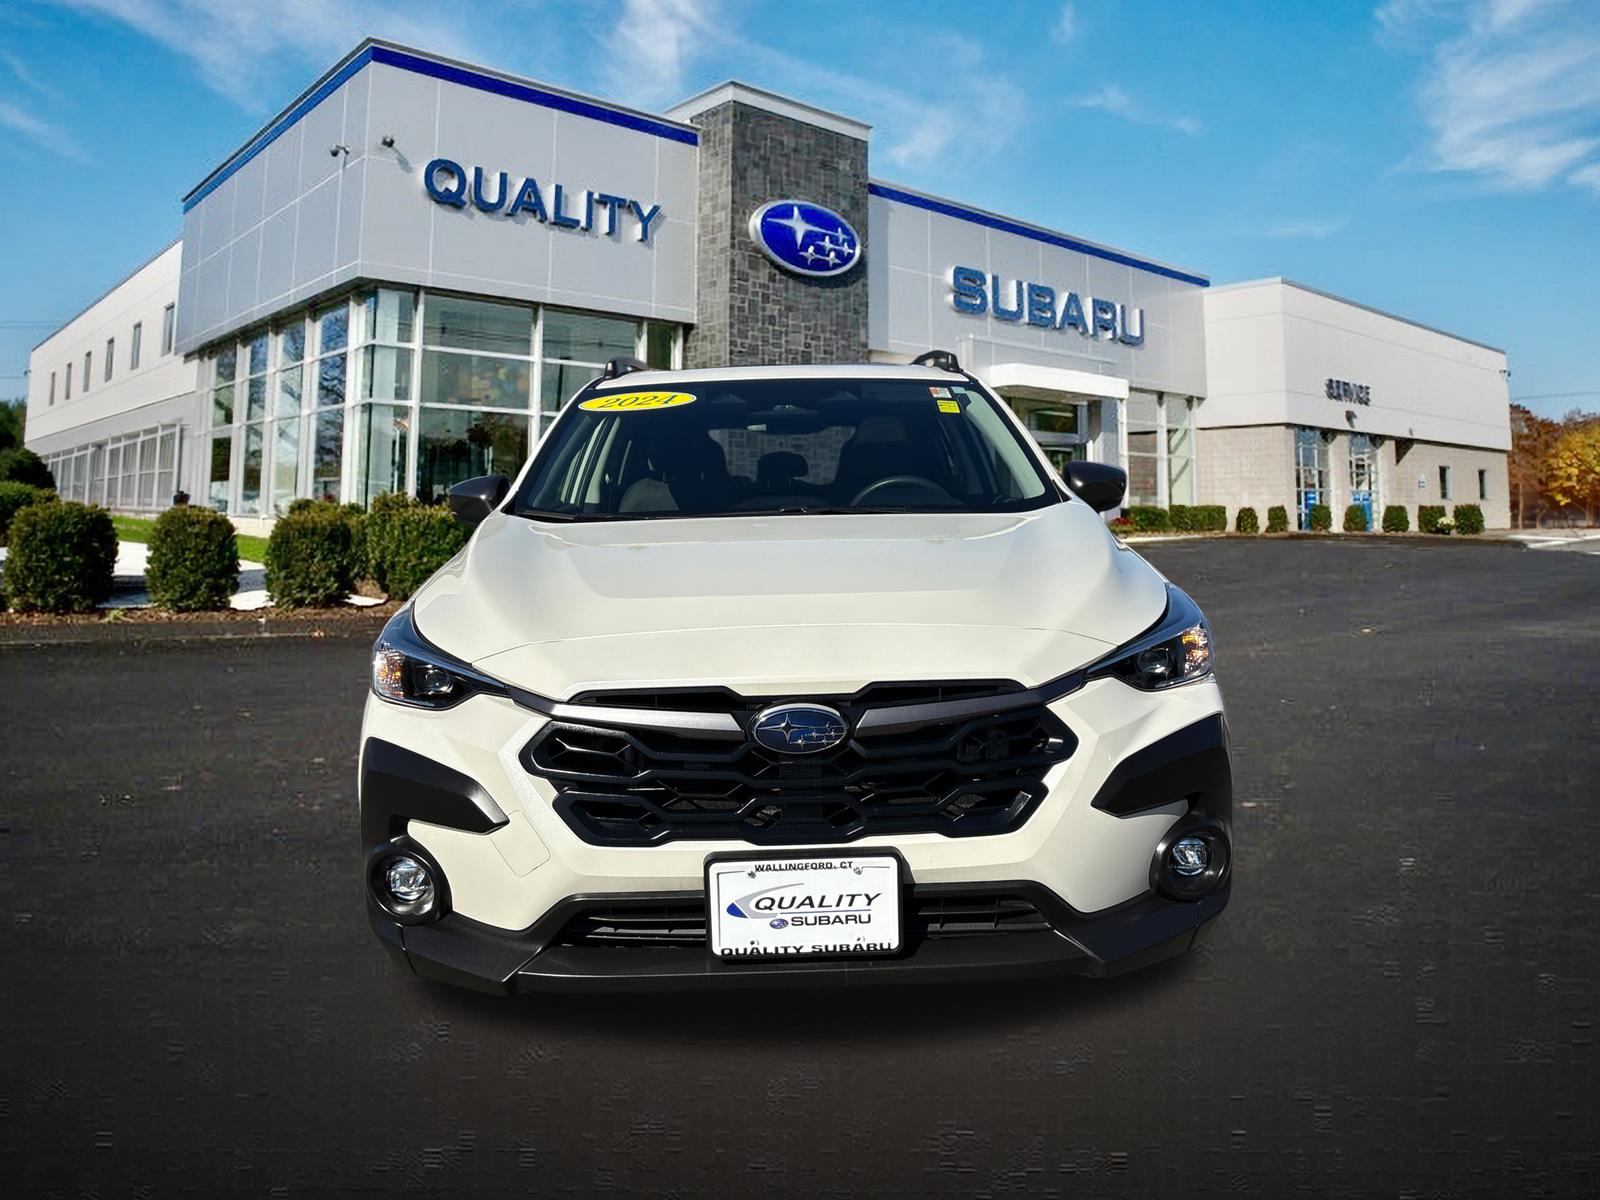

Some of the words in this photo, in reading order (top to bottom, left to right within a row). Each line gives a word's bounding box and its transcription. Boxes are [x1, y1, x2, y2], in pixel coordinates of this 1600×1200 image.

[423, 157, 662, 243] QUALITY
[951, 265, 1146, 347] SUBARU
[597, 394, 679, 409] 2024
[839, 860, 854, 870] CT
[754, 892, 883, 912] QUALITY
[790, 913, 872, 927] SUBARU
[720, 945, 804, 957] QUALITY
[811, 942, 892, 954] SUBARU
